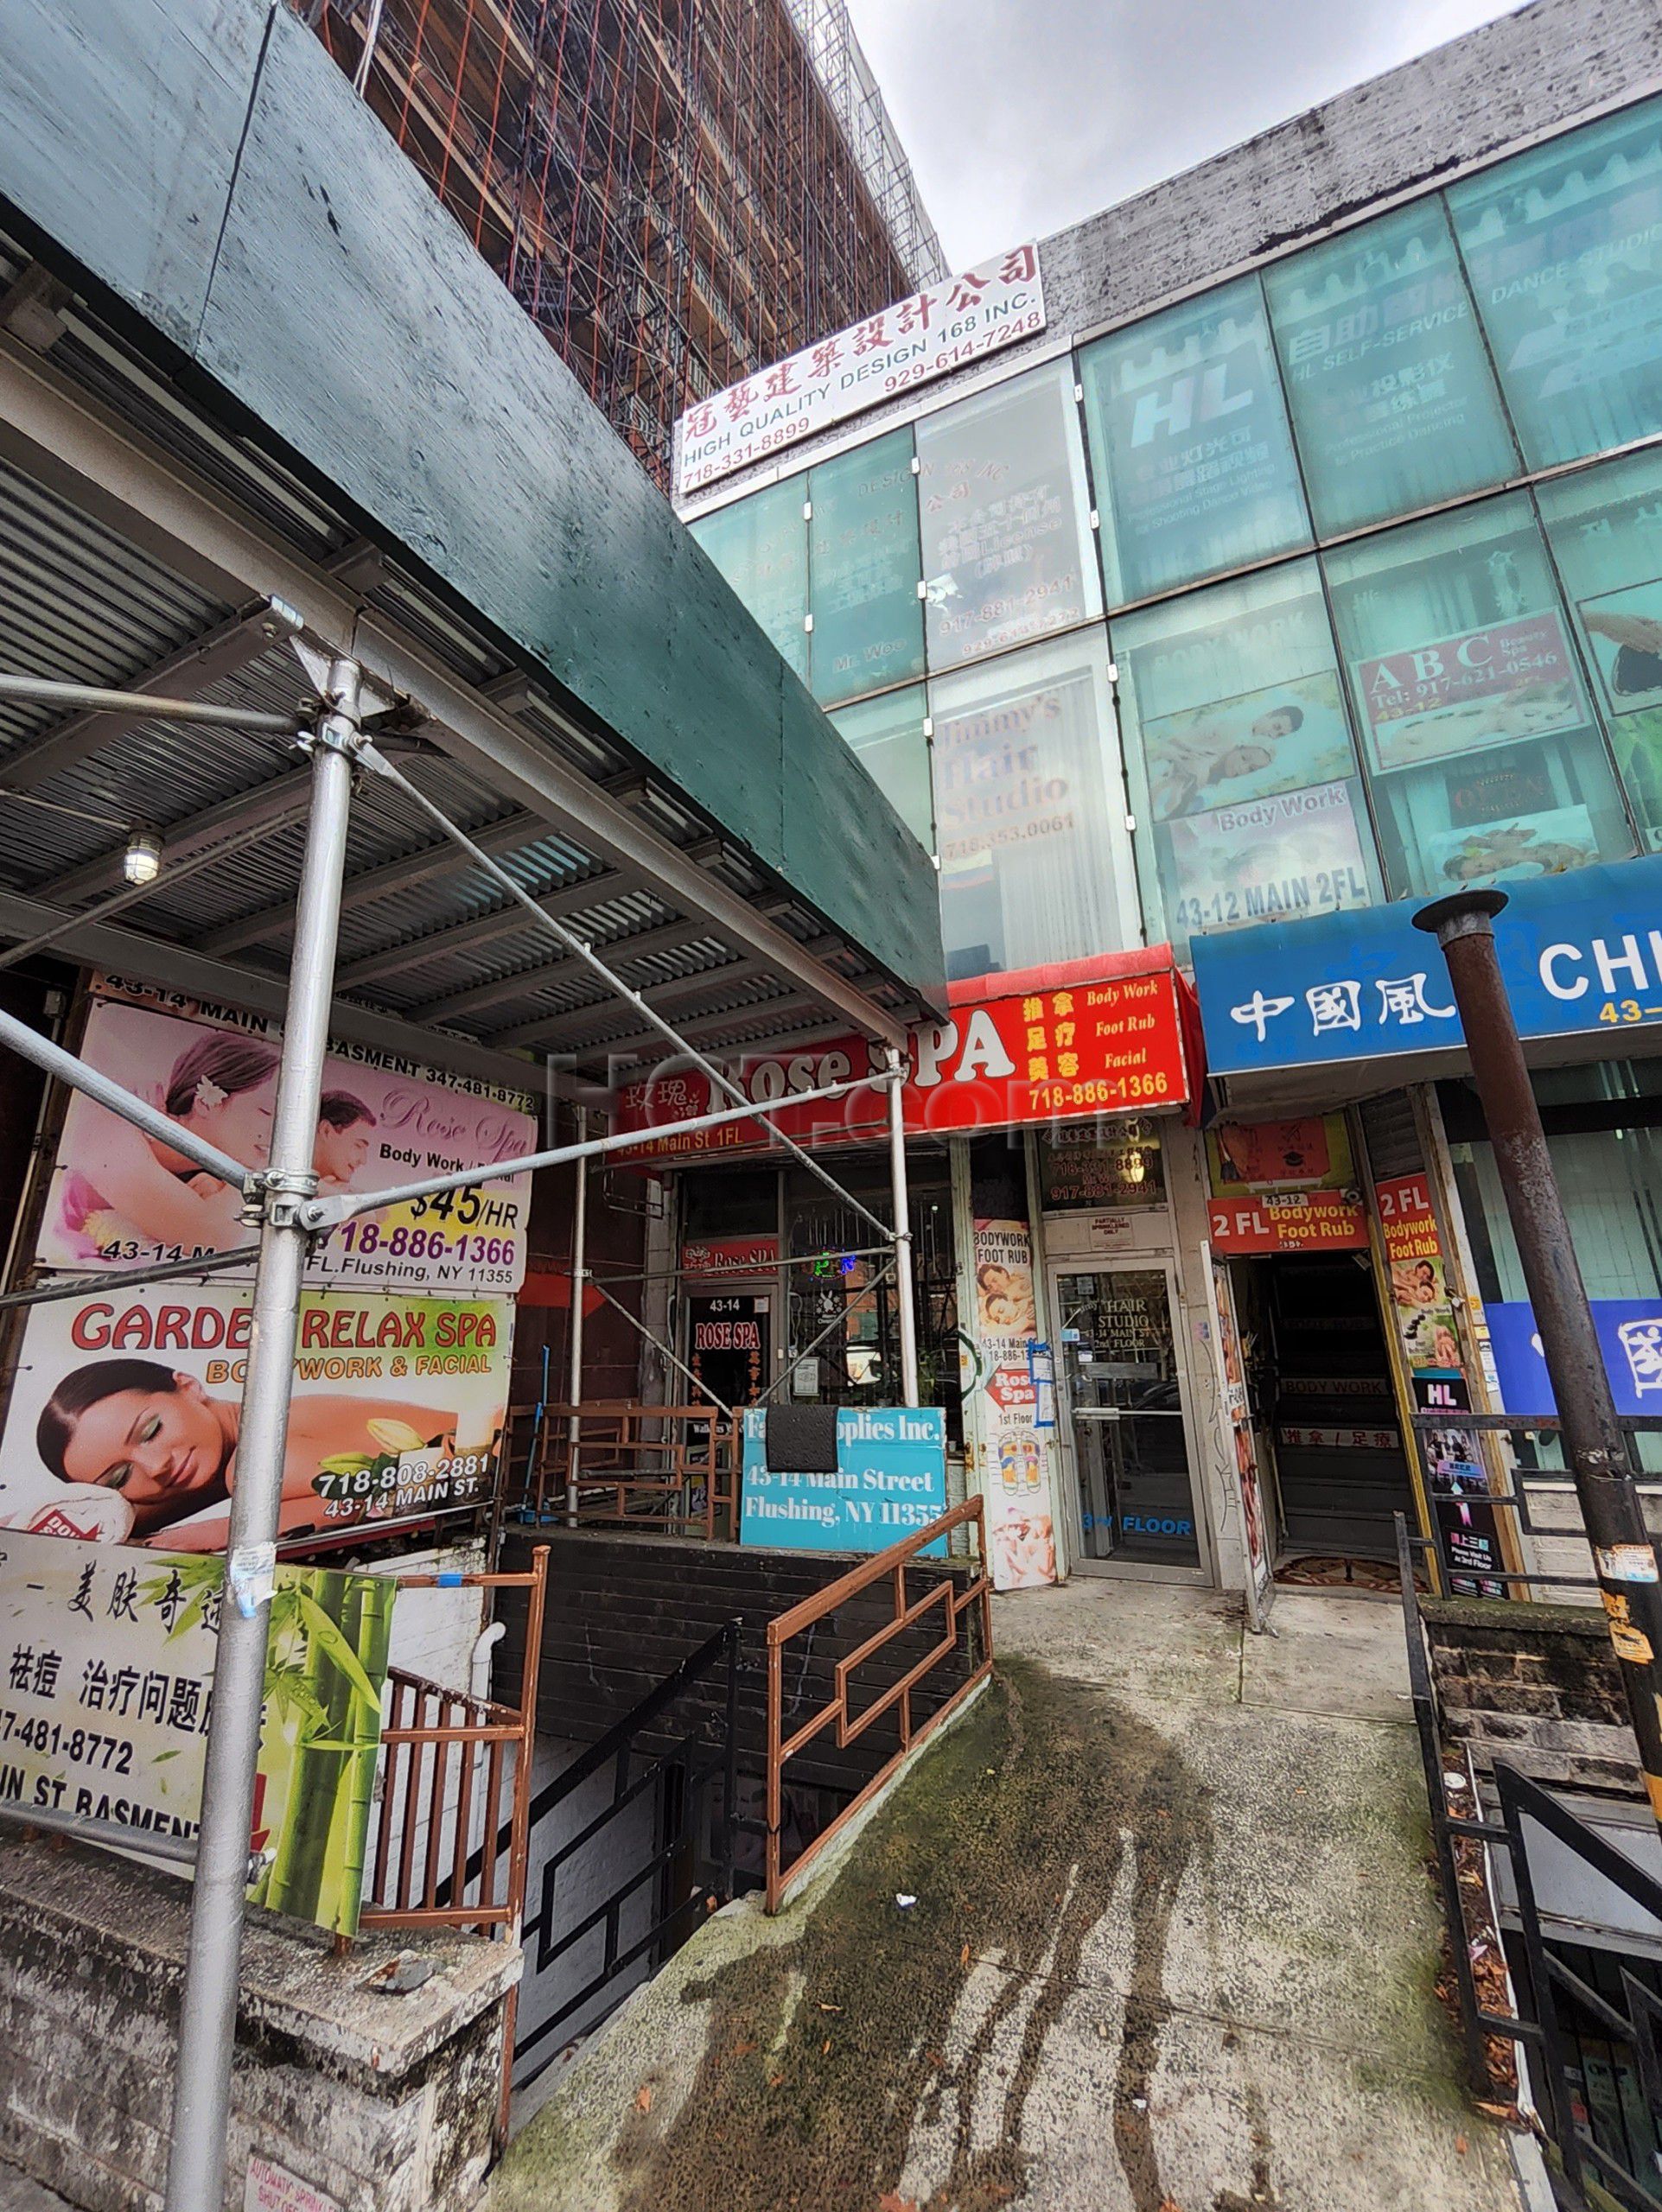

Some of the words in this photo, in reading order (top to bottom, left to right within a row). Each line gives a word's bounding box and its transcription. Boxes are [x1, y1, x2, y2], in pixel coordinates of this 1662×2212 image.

[1490, 261, 1572, 305] DANCE
[1322, 300, 1469, 372] SELF-SERVICE
[884, 311, 1042, 392] 929-614-7248
[683, 430, 732, 467] HIGH
[740, 384, 831, 438] QUALITY
[840, 342, 927, 391] DESIGN
[937, 315, 978, 345] 168
[984, 292, 1036, 322] INC.
[1131, 361, 1256, 451] HL
[682, 417, 811, 489] 718-331-8899
[1369, 663, 1404, 695] A
[1410, 650, 1444, 683] B
[1455, 635, 1494, 668] C
[1372, 690, 1410, 709] Tel:
[1219, 802, 1277, 833] Body
[1282, 785, 1346, 818] Work
[1176, 890, 1239, 931] 43-12
[1245, 875, 1312, 918] MAIN
[1315, 865, 1366, 906] 2FL
[1086, 985, 1120, 1009] Body
[1121, 979, 1159, 1004] Work
[1231, 972, 1457, 1042] 中國風
[1094, 1015, 1125, 1038] Foot
[1126, 1012, 1156, 1033] Rub
[105, 973, 188, 1010] 43-14
[199, 999, 270, 1035] MAIN
[425, 1067, 535, 1110] 347-481-8772
[1105, 1046, 1148, 1068] Facial
[1028, 1071, 1168, 1109] 718-886-1366
[380, 1088, 468, 1140] Rose
[475, 1114, 528, 1158] Spa
[657, 1134, 699, 1153] Main
[694, 1130, 710, 1149] St
[717, 1126, 743, 1147] 1FL
[379, 1142, 422, 1169] Body
[427, 1151, 464, 1173] Work
[1050, 1180, 1157, 1201] 917-881-2941
[1266, 1194, 1302, 1205] 43-12
[1381, 1193, 1395, 1217] 2
[1398, 1185, 1430, 1211] FL
[1213, 1216, 1231, 1237] 2
[1235, 1211, 1270, 1236] FL
[1269, 1205, 1359, 1223] Bodywork
[1384, 1214, 1438, 1241] Bodywork
[973, 1231, 1030, 1248] BODYWORK
[1277, 1223, 1318, 1239] Foot
[1320, 1221, 1356, 1237] Rub
[977, 1249, 1005, 1264] FOOT
[1008, 1248, 1028, 1264] RUB
[1389, 1242, 1414, 1260] Foot
[1415, 1236, 1438, 1255] Rub
[103, 1240, 181, 1261] 43-14
[437, 1262, 463, 1281] NY
[468, 1266, 513, 1285] 11355
[709, 1299, 741, 1312] 43-14
[71, 1302, 257, 1351] GARDE
[302, 1310, 425, 1351] RELAX
[435, 1313, 498, 1349] SPA
[1098, 1315, 1149, 1328] STUDIO
[695, 1323, 731, 1350] ROSE
[734, 1322, 761, 1350] SPA
[1008, 1336, 1029, 1350] Main
[1113, 1339, 1146, 1348] FLOOR
[390, 1355, 408, 1376] &
[415, 1354, 492, 1375] FACIAL
[995, 1372, 1030, 1388] Ros
[1285, 1381, 1328, 1395] BODY
[1333, 1380, 1383, 1395] WORK
[1000, 1387, 1035, 1404] Spa
[1427, 1383, 1458, 1406] HL
[837, 1414, 895, 1448] pplies
[899, 1414, 940, 1441] Inc.
[998, 1413, 1012, 1426] 1st
[1013, 1413, 1034, 1426] Floor
[318, 1453, 490, 1498] 718-808-2881
[806, 1469, 859, 1490] Main
[863, 1469, 934, 1492] Street
[324, 1493, 388, 1519] 43-14
[392, 1482, 447, 1507] MAIN
[449, 1475, 478, 1497] ST.
[745, 1497, 841, 1529] Flushing,
[844, 1501, 876, 1523] NY
[880, 1503, 943, 1527] 11355
[1123, 1516, 1192, 1536] FLOOR
[1474, 1559, 1493, 1570] Floor
[33, 1774, 67, 1810] ST
